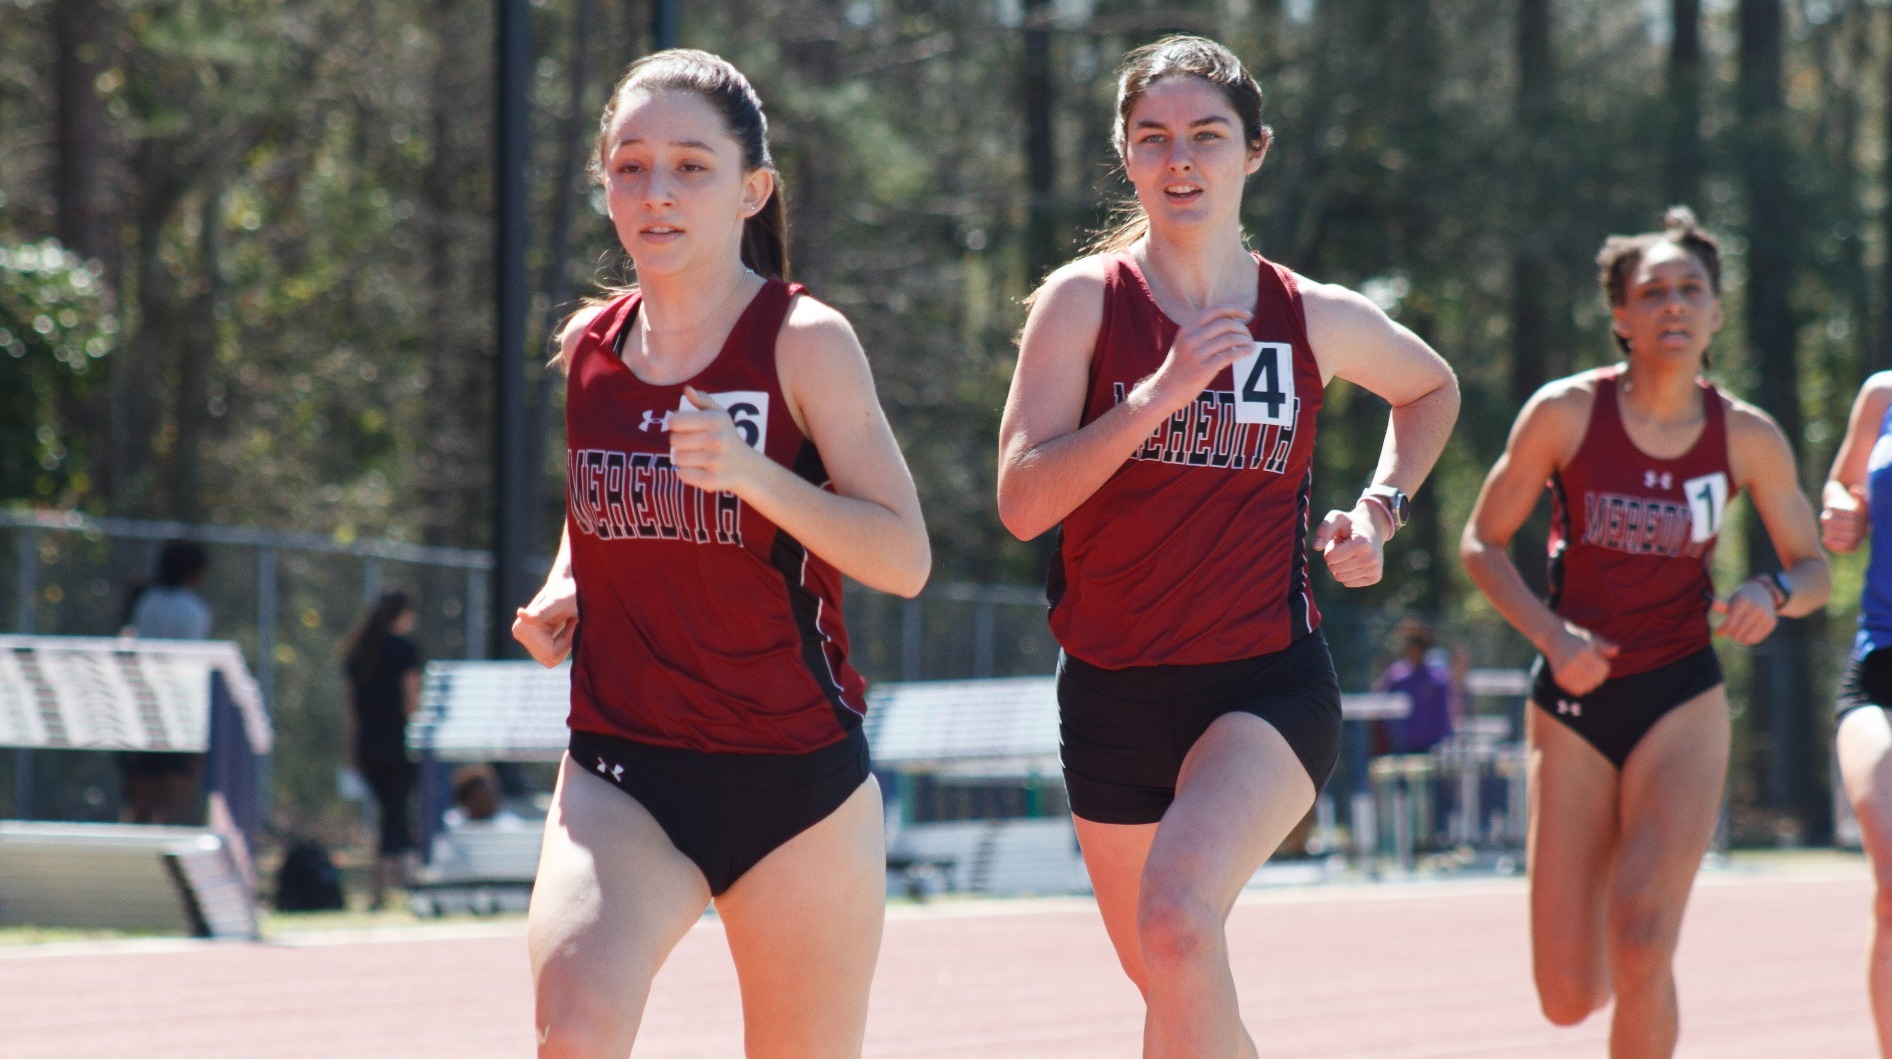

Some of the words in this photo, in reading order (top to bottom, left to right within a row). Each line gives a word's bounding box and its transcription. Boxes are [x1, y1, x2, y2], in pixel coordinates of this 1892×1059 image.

[1242, 347, 1286, 419] 4
[727, 402, 760, 448] 6
[1113, 382, 1301, 474] REDIH
[1581, 489, 1700, 560] MEREDI
[1695, 482, 1715, 533] 1
